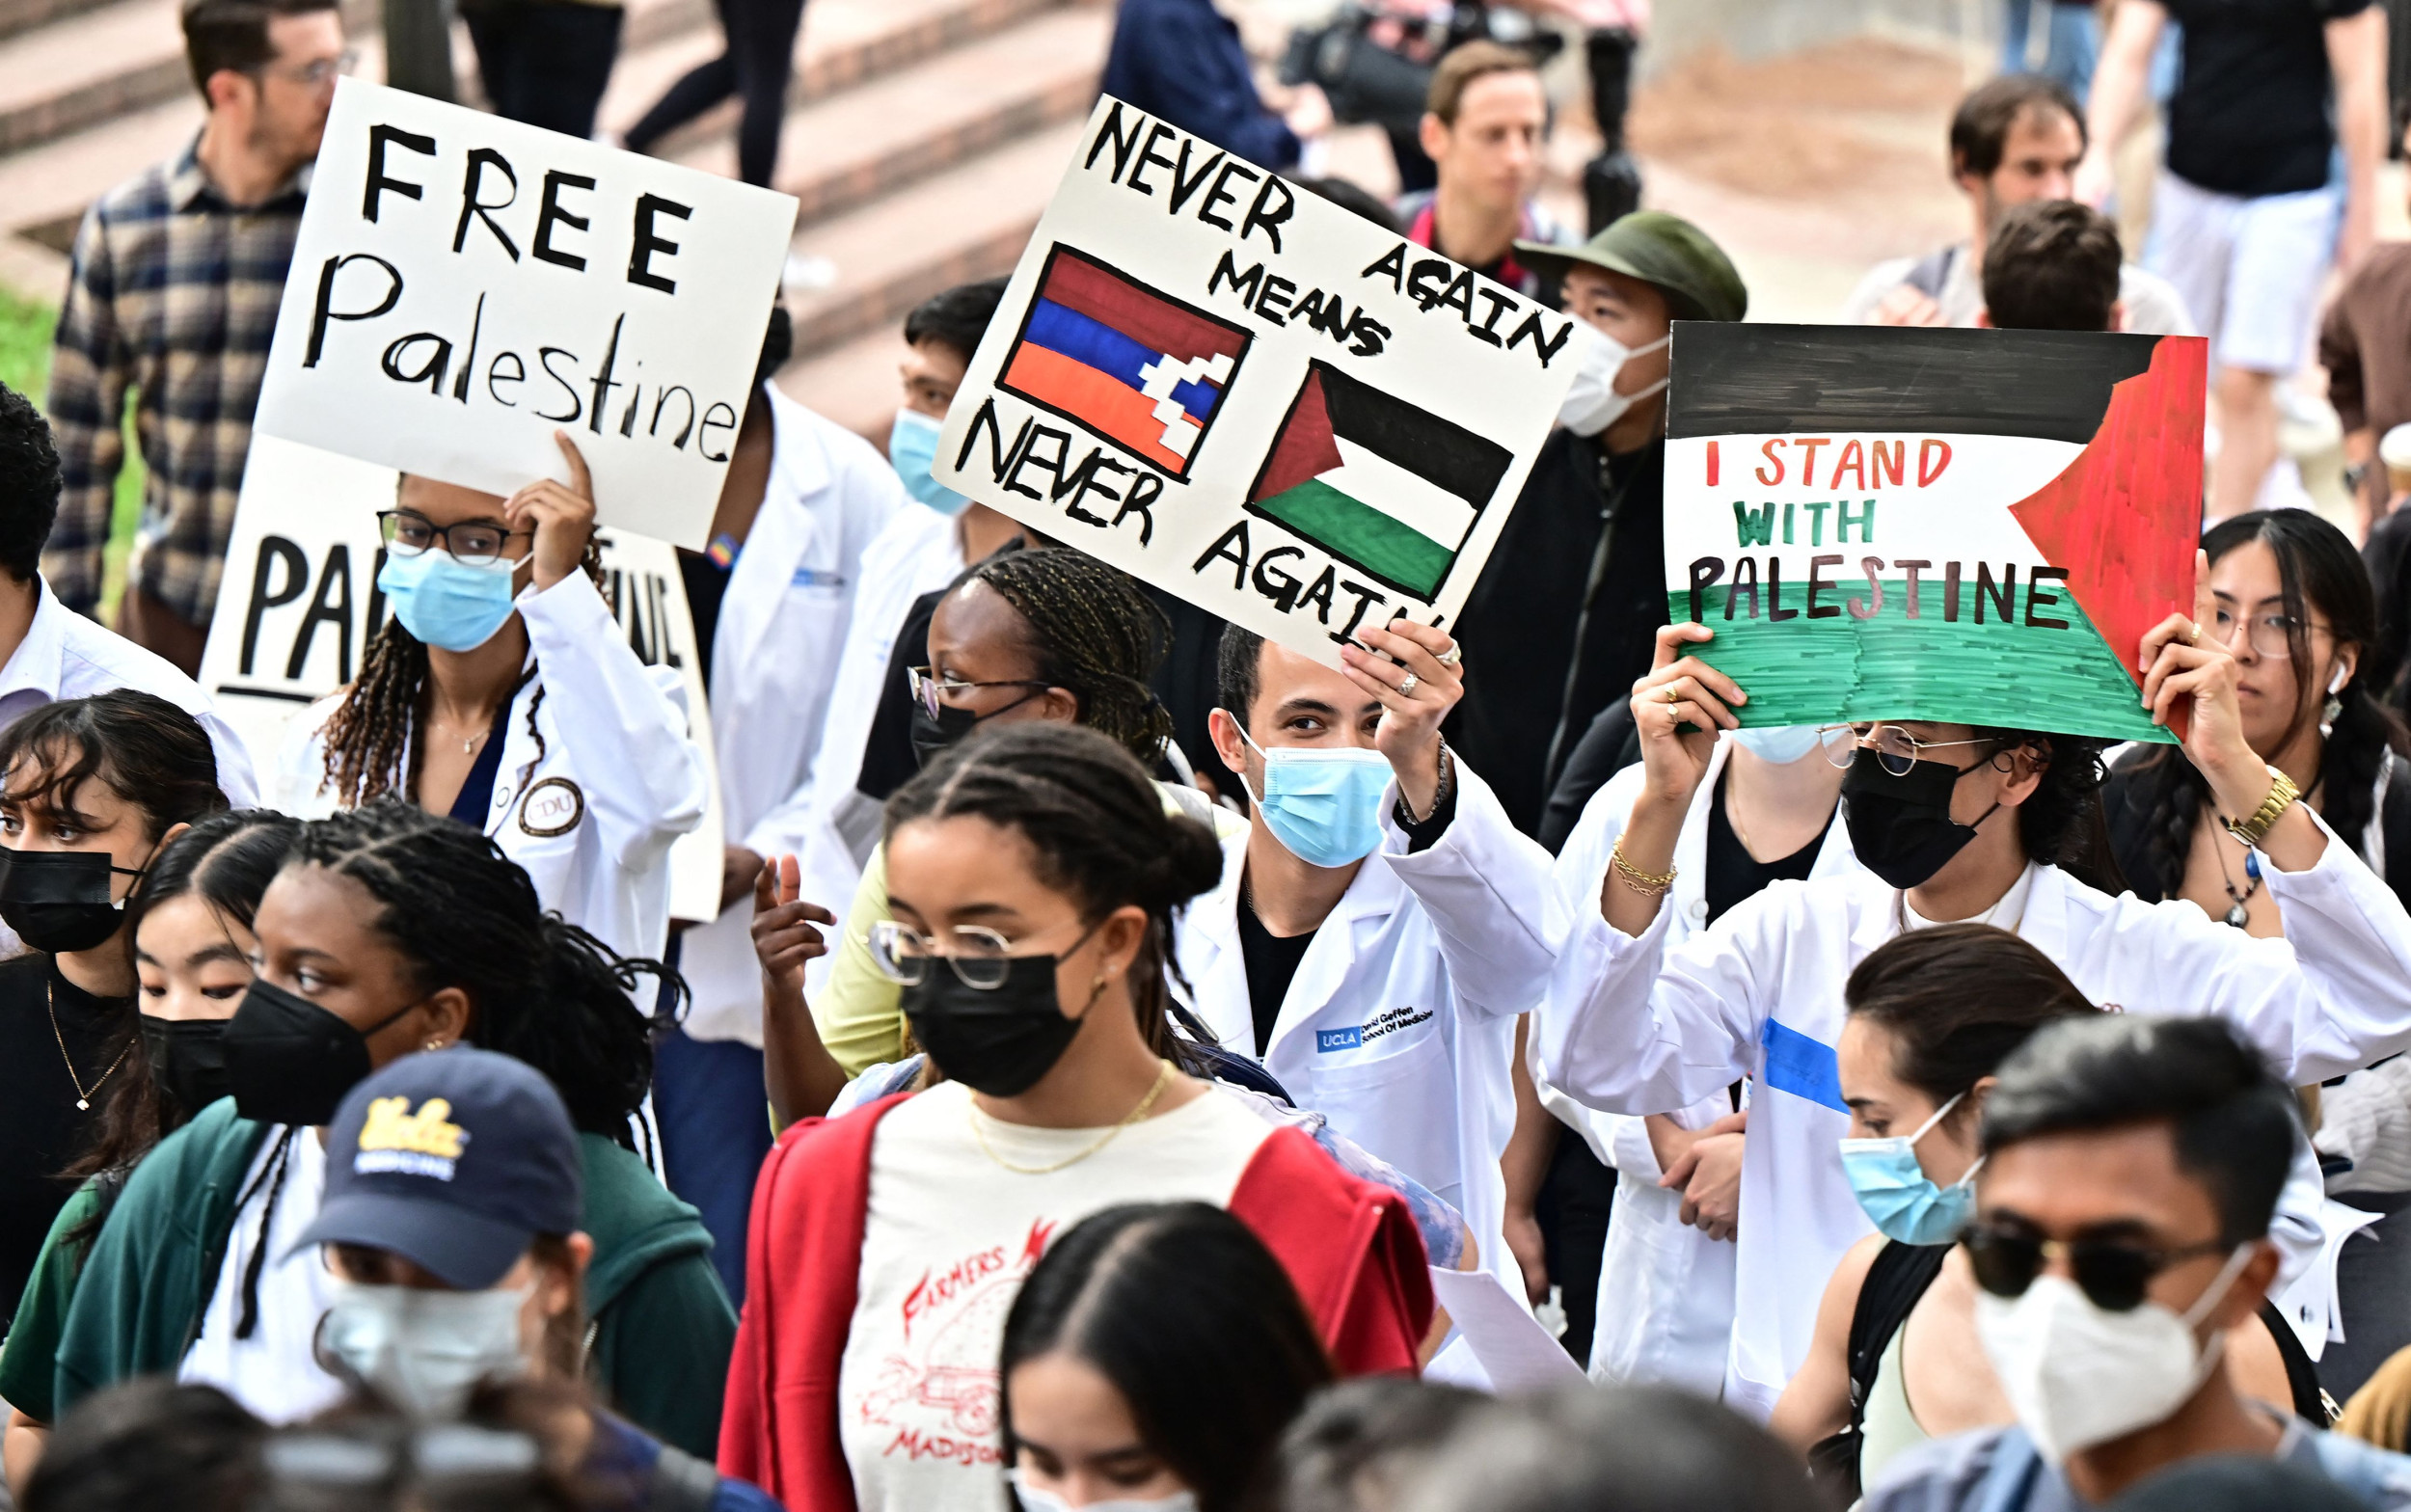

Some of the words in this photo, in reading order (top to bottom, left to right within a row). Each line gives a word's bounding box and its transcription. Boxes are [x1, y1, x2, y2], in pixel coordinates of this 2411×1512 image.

[363, 124, 692, 294] FREE
[1085, 101, 1294, 254] NEVER
[1362, 243, 1573, 368] AGAIN
[1208, 249, 1392, 356] MEANS
[303, 254, 737, 463] Palestine
[955, 396, 1163, 546] NEVER
[1706, 441, 1720, 486] I
[1755, 439, 1952, 490] STAND
[1733, 500, 1876, 547] WITH
[1689, 554, 2070, 630] PALESTINE
[1322, 1032, 1357, 1047] UCLA
